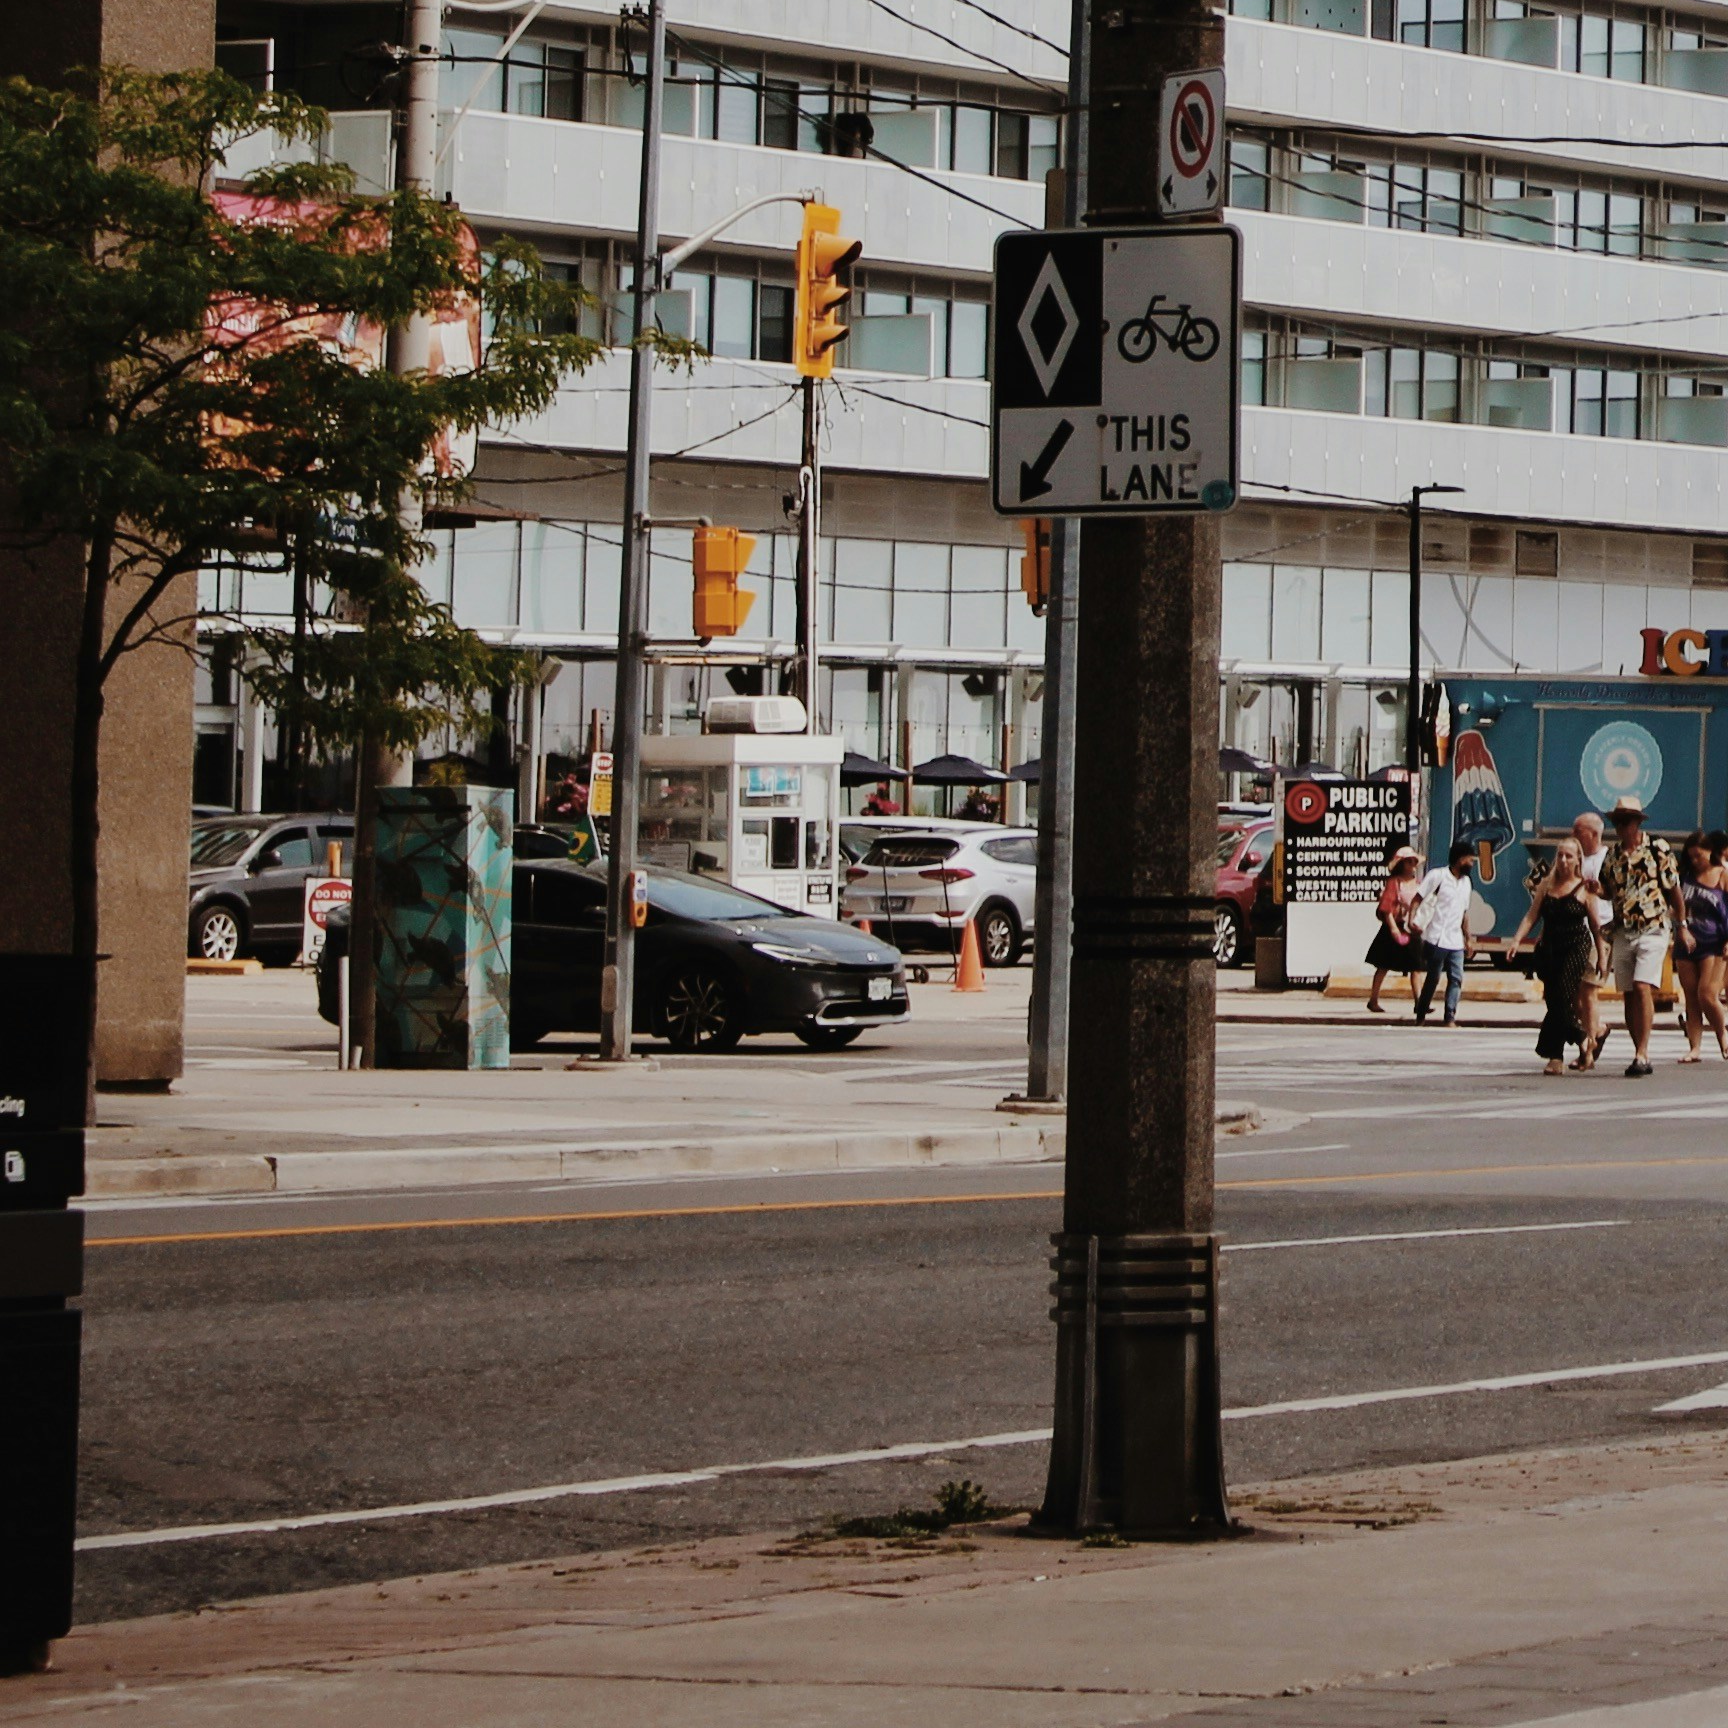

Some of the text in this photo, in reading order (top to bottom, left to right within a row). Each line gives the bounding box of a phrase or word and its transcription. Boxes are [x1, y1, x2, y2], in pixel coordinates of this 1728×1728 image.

[1109, 413, 1191, 452] THIS
[1100, 463, 1199, 501] LANE
[1301, 796, 1312, 811] P
[1329, 786, 1398, 809] PUBLIC
[1324, 811, 1407, 833] PARKING
[1296, 836, 1388, 848] HARBOURFRONT
[1296, 851, 1384, 862] CENTRE ISLAND
[1295, 866, 1368, 877] SCOTIABANK
[1295, 880, 1386, 891] WESTIN HARBOU
[315, 889, 331, 899] DO
[1295, 891, 1378, 902] CASTLE HOTEL
